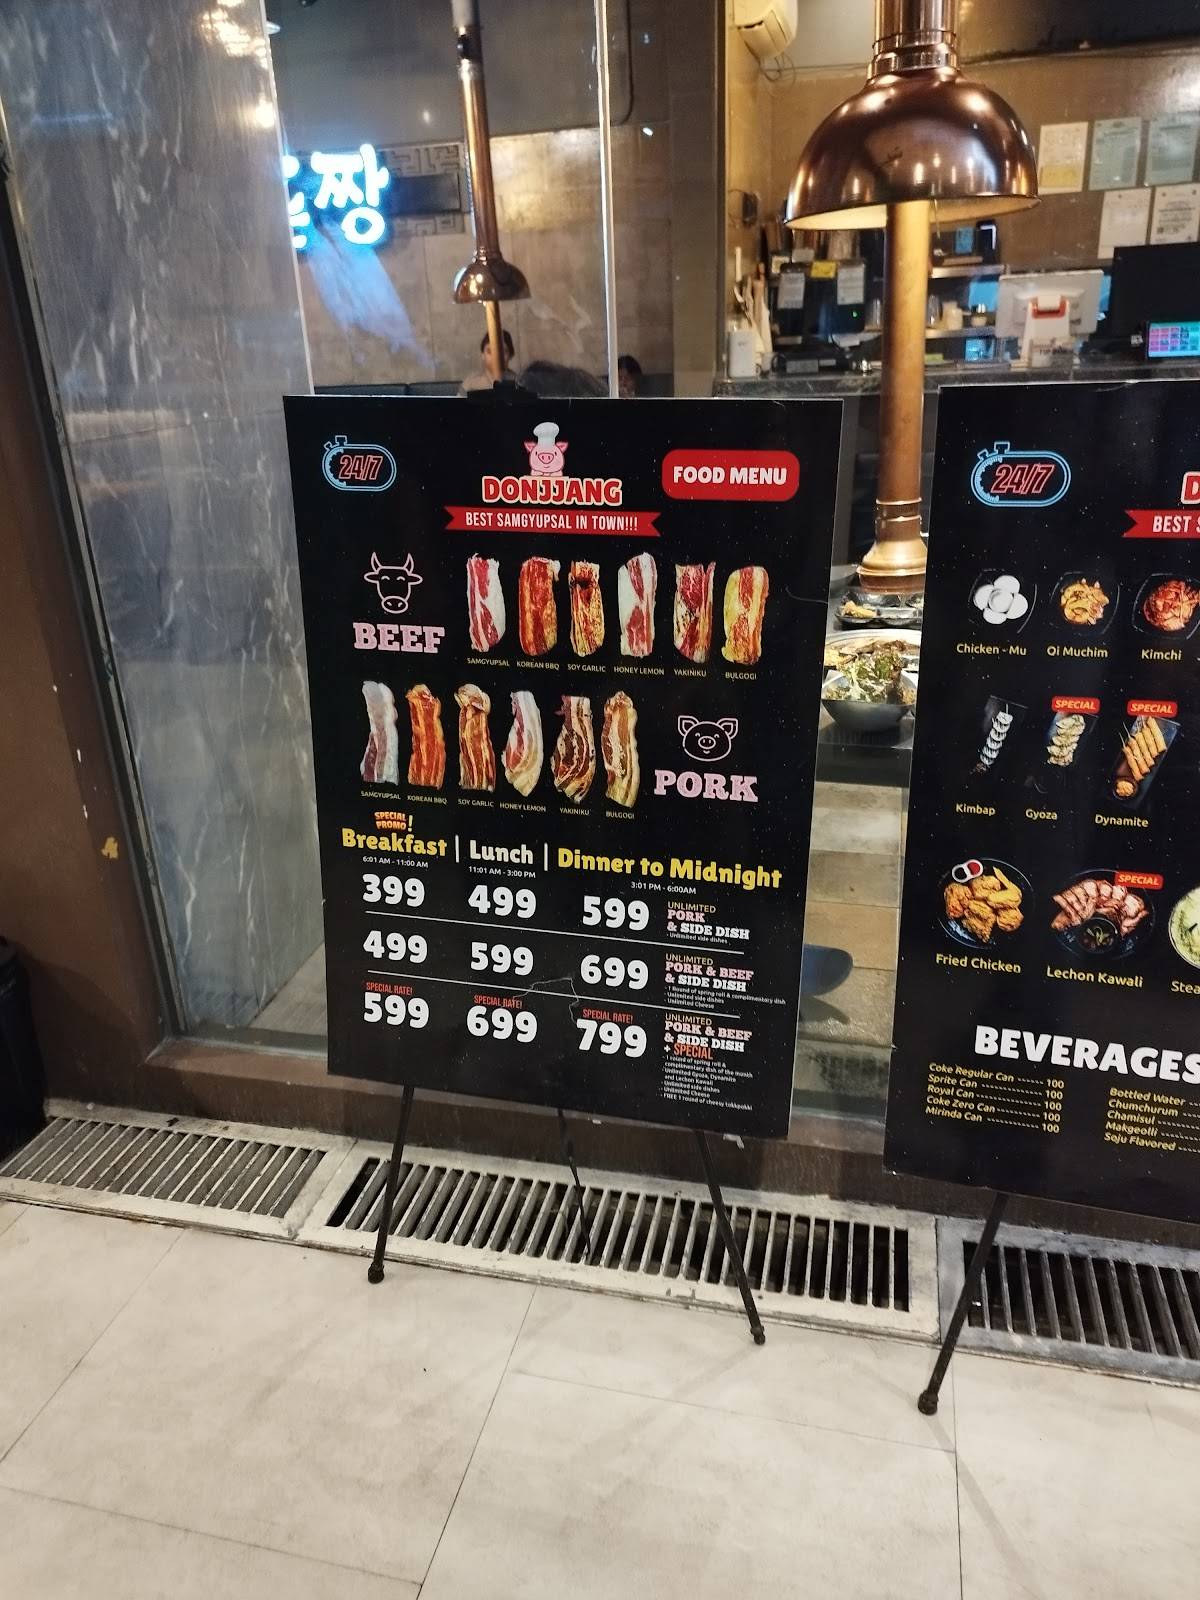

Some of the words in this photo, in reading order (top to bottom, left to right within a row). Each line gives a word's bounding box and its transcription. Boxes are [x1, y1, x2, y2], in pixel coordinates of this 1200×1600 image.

[339, 455, 383, 481] 24/7
[673, 466, 726, 484] FOOD
[729, 467, 787, 485] MENU
[990, 464, 1055, 495] 24/7
[482, 475, 622, 505] DONJJANG
[466, 512, 493, 526] BEST
[497, 513, 572, 528] SAMGYUPSAL
[576, 516, 587, 528] IN
[592, 516, 638, 531] TOWN!!!
[1153, 516, 1191, 533] BEST
[352, 622, 444, 654] BEEF
[957, 643, 999, 655] Chicken
[1009, 646, 1027, 656] Mu
[1063, 647, 1108, 658] Muchim
[1142, 650, 1182, 660] Kimchi
[467, 658, 509, 666] SAMGYUPSAL
[516, 661, 544, 669] KOREAN
[582, 664, 606, 672] GARLIC
[614, 666, 638, 675] HONEY
[640, 667, 664, 675] LEMON
[674, 668, 707, 677] YAKINIKU
[725, 672, 756, 680] BULGOGI
[1055, 700, 1096, 710] SPECIAL
[1131, 704, 1173, 714] SPECIAL
[654, 769, 758, 802] PORK
[360, 791, 400, 799] SAMGYUPSAL
[408, 795, 432, 803] KOREAN
[434, 797, 447, 805] BBQ
[472, 799, 494, 807] GARLIC
[500, 803, 522, 811] HONEY
[523, 804, 546, 812] LEMON
[559, 807, 589, 815] YAKINIKU
[606, 811, 634, 819] BULGOGI
[956, 803, 995, 816] Kimbap
[1025, 809, 1058, 821] Gyoza
[374, 812, 406, 821] SPECIAL
[1095, 814, 1149, 828] Dynamite
[342, 828, 447, 856] Breakfast
[470, 840, 533, 864] Lunch
[469, 866, 487, 874] 11:01
[558, 847, 635, 874] Dinner
[640, 858, 664, 877] to
[670, 858, 782, 891] Midnight
[649, 883, 661, 891] PM
[667, 885, 696, 894] 6:00AM
[1119, 874, 1160, 886] SPECIAL
[362, 874, 425, 907] 399
[468, 885, 536, 918] 499
[668, 901, 716, 913] UNLIMITED
[582, 895, 649, 930] 599
[668, 910, 705, 922] PORK
[667, 921, 677, 931] &
[680, 923, 712, 935] SIDE
[716, 926, 750, 940] DISH
[363, 930, 428, 963] 499
[470, 942, 534, 976] 599
[666, 953, 713, 965] UNLIMITED
[936, 953, 967, 967] Fried
[971, 957, 1021, 973] Chicken
[580, 954, 648, 990] 699
[665, 961, 702, 975] PORK
[706, 966, 716, 976] &
[720, 967, 754, 980] BEEF
[1047, 965, 1094, 982] Lechon
[1097, 972, 1143, 988] Kawali
[366, 982, 392, 994] SPECIAL
[394, 984, 412, 996] RATE!
[665, 973, 675, 983] &
[678, 975, 709, 987] SIDE
[713, 978, 746, 992] DISH
[364, 992, 429, 1028] 599
[474, 996, 500, 1006] SPECIAL
[503, 998, 522, 1009] RATE!
[466, 1006, 537, 1042] 699
[583, 1009, 610, 1021] SPECIAL
[612, 1012, 633, 1023] RATE!
[665, 1013, 712, 1025] UNLIMITED
[576, 1018, 647, 1058] 799
[665, 1021, 701, 1034] PORK
[705, 1026, 715, 1036] &
[718, 1027, 752, 1040] BEEF
[664, 1032, 674, 1043] &
[677, 1034, 708, 1047] SIDE
[711, 1038, 744, 1052] DISH
[674, 1043, 713, 1060] SPECIAL
[975, 1025, 1200, 1085] BEVERAGES
[929, 1063, 953, 1073] Coke
[956, 1066, 994, 1079] Regular
[996, 1072, 1014, 1082] Can
[1047, 1079, 1064, 1089] 100
[928, 1074, 957, 1085] Sprite
[960, 1078, 977, 1088] Can
[1046, 1090, 1063, 1100] 100
[928, 1084, 954, 1095] Royal
[956, 1089, 974, 1098] Can
[1044, 1101, 1062, 1111] 100
[1110, 1087, 1151, 1101] Bottled
[1153, 1093, 1186, 1106] Water
[927, 1095, 950, 1106] Coke
[952, 1100, 974, 1109] Zero
[977, 1103, 995, 1113] Can
[1043, 1112, 1060, 1122] 100
[1109, 1099, 1178, 1116] Chumchurum
[926, 1106, 962, 1119] Mirinda
[964, 1112, 982, 1122] Can
[1042, 1123, 1059, 1133] 100
[1107, 1110, 1155, 1124] Chamisul
[1106, 1121, 1158, 1136] Makgeolli
[1104, 1132, 1127, 1144] Soju
[1129, 1136, 1176, 1150] Flavored
